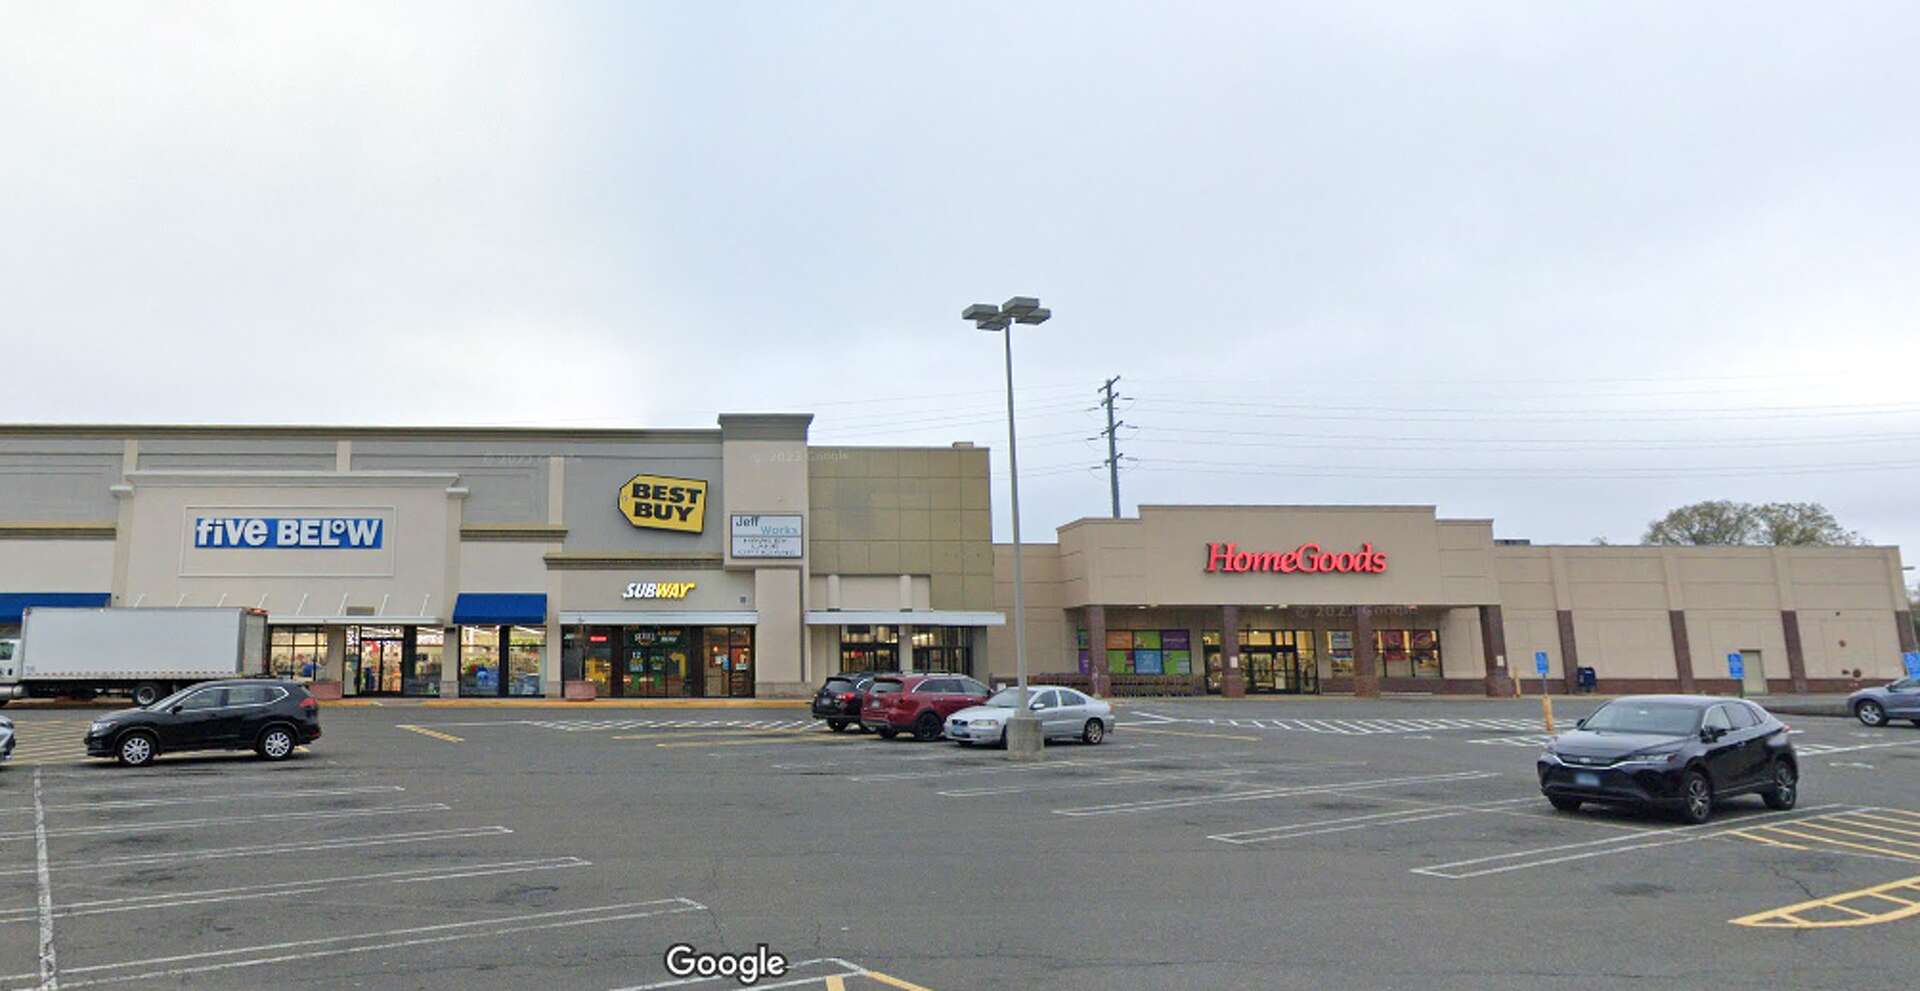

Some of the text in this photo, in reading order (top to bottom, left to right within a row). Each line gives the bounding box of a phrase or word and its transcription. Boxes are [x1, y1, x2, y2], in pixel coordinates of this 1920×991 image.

[632, 483, 703, 505] BEST
[634, 501, 695, 522] BUY
[197, 517, 269, 547] five
[1205, 542, 1387, 574] HomeGoods
[622, 582, 696, 599] SUBWAY
